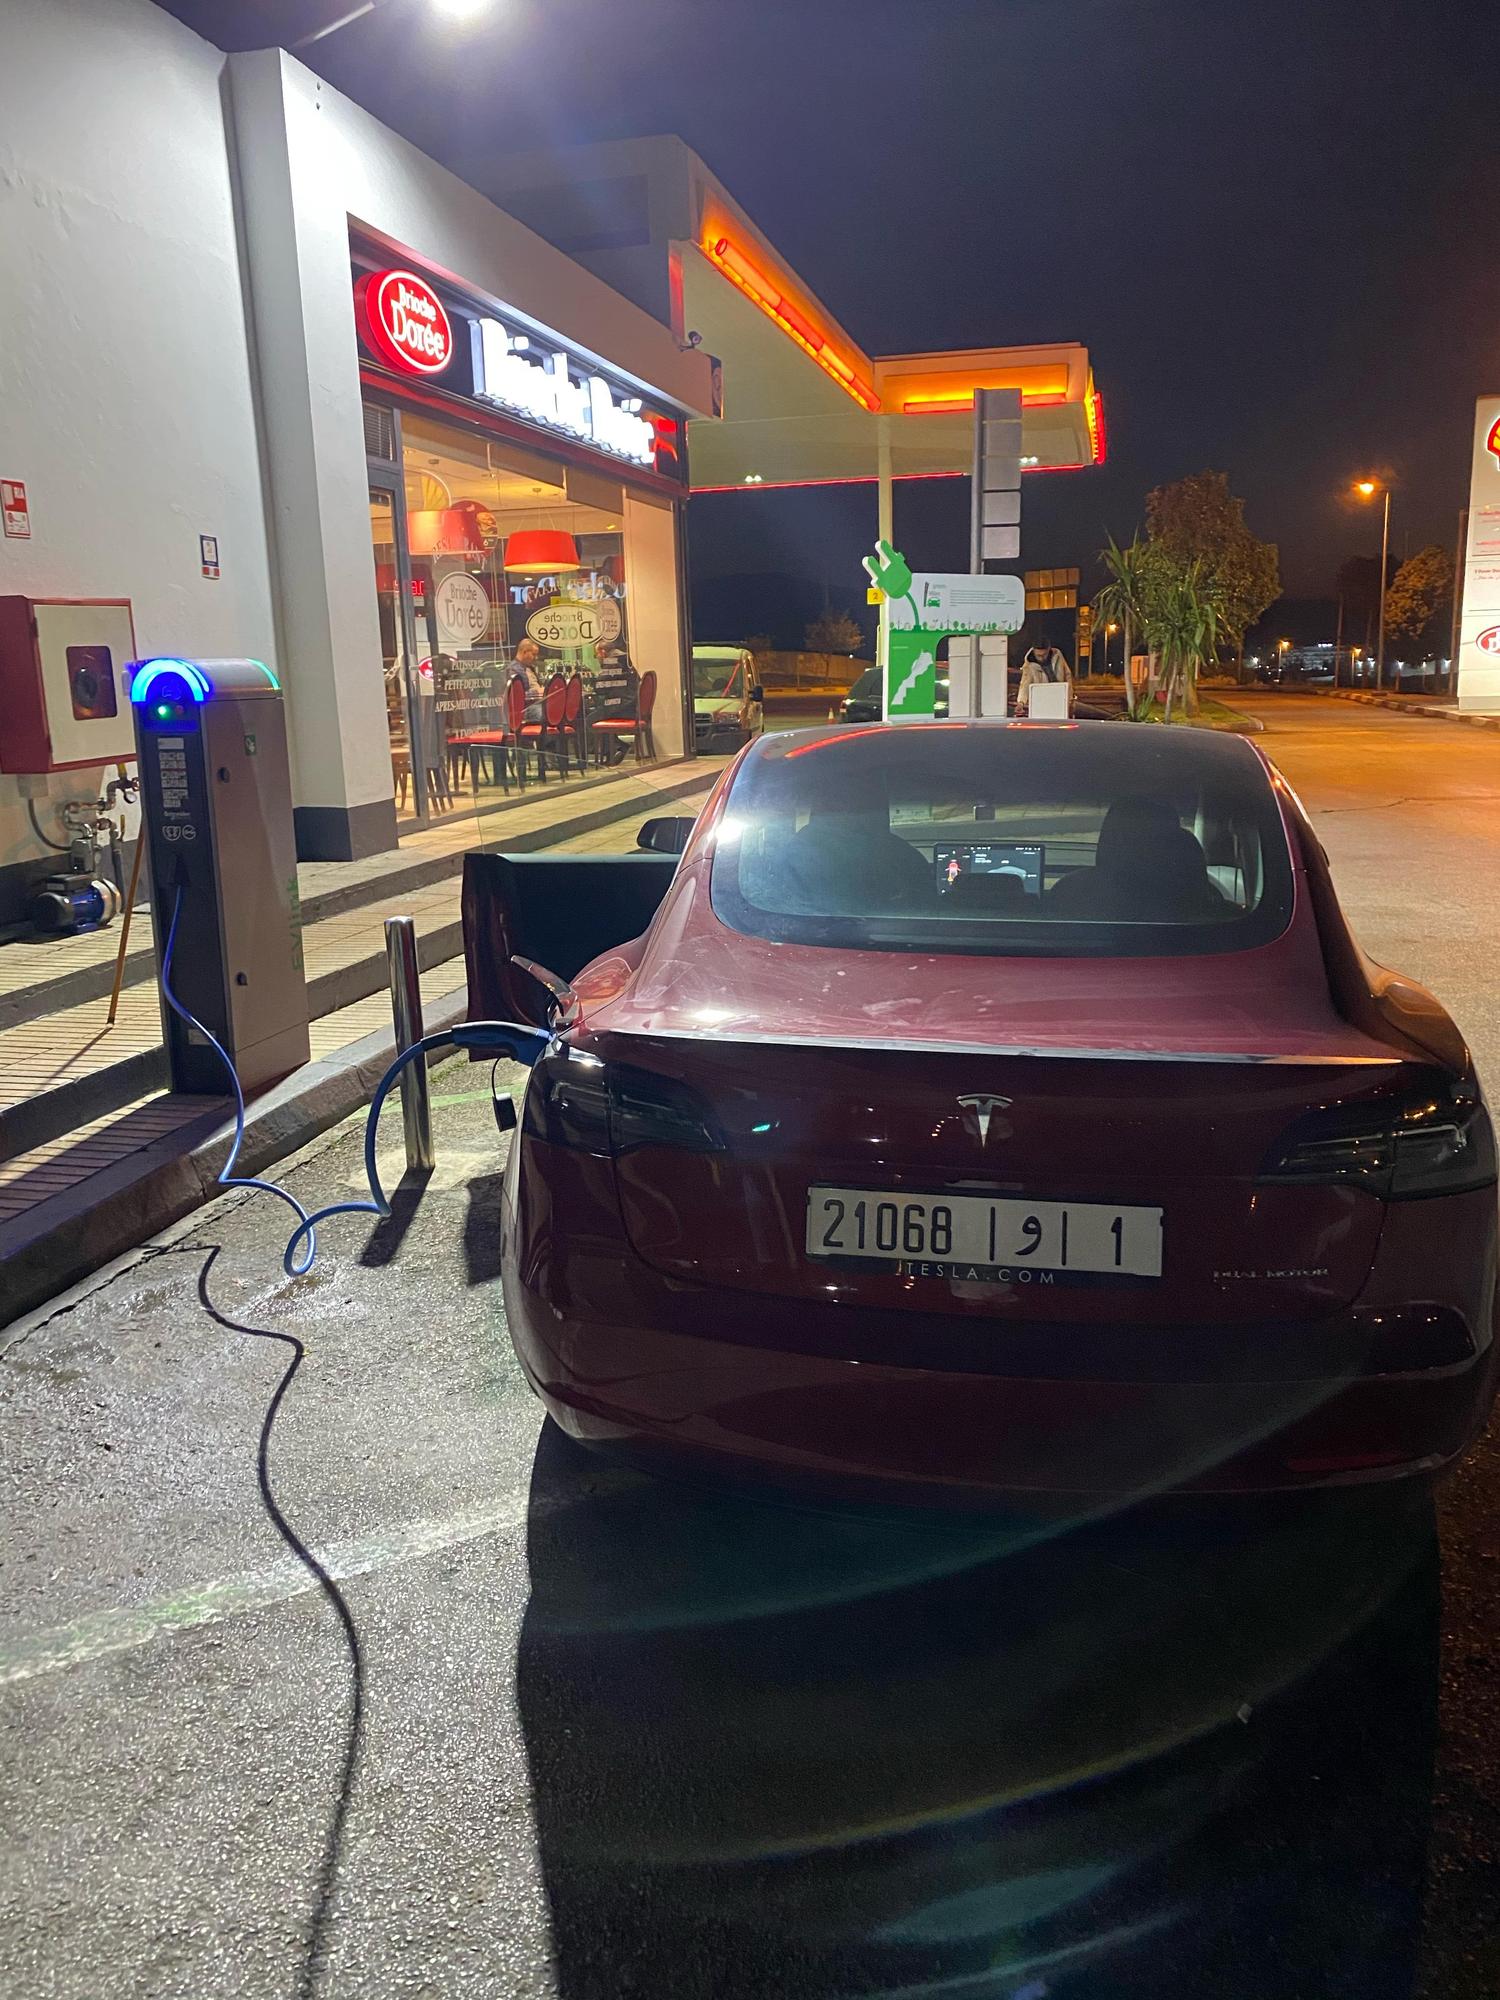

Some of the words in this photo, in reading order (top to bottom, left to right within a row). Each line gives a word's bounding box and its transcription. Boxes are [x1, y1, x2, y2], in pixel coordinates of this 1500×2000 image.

[397, 281, 437, 322] Brioche
[390, 298, 445, 360] Dorée
[445, 598, 484, 629] Dorée
[822, 1198, 953, 1255] 21068
[906, 1261, 1055, 1284] TESLA.COM
